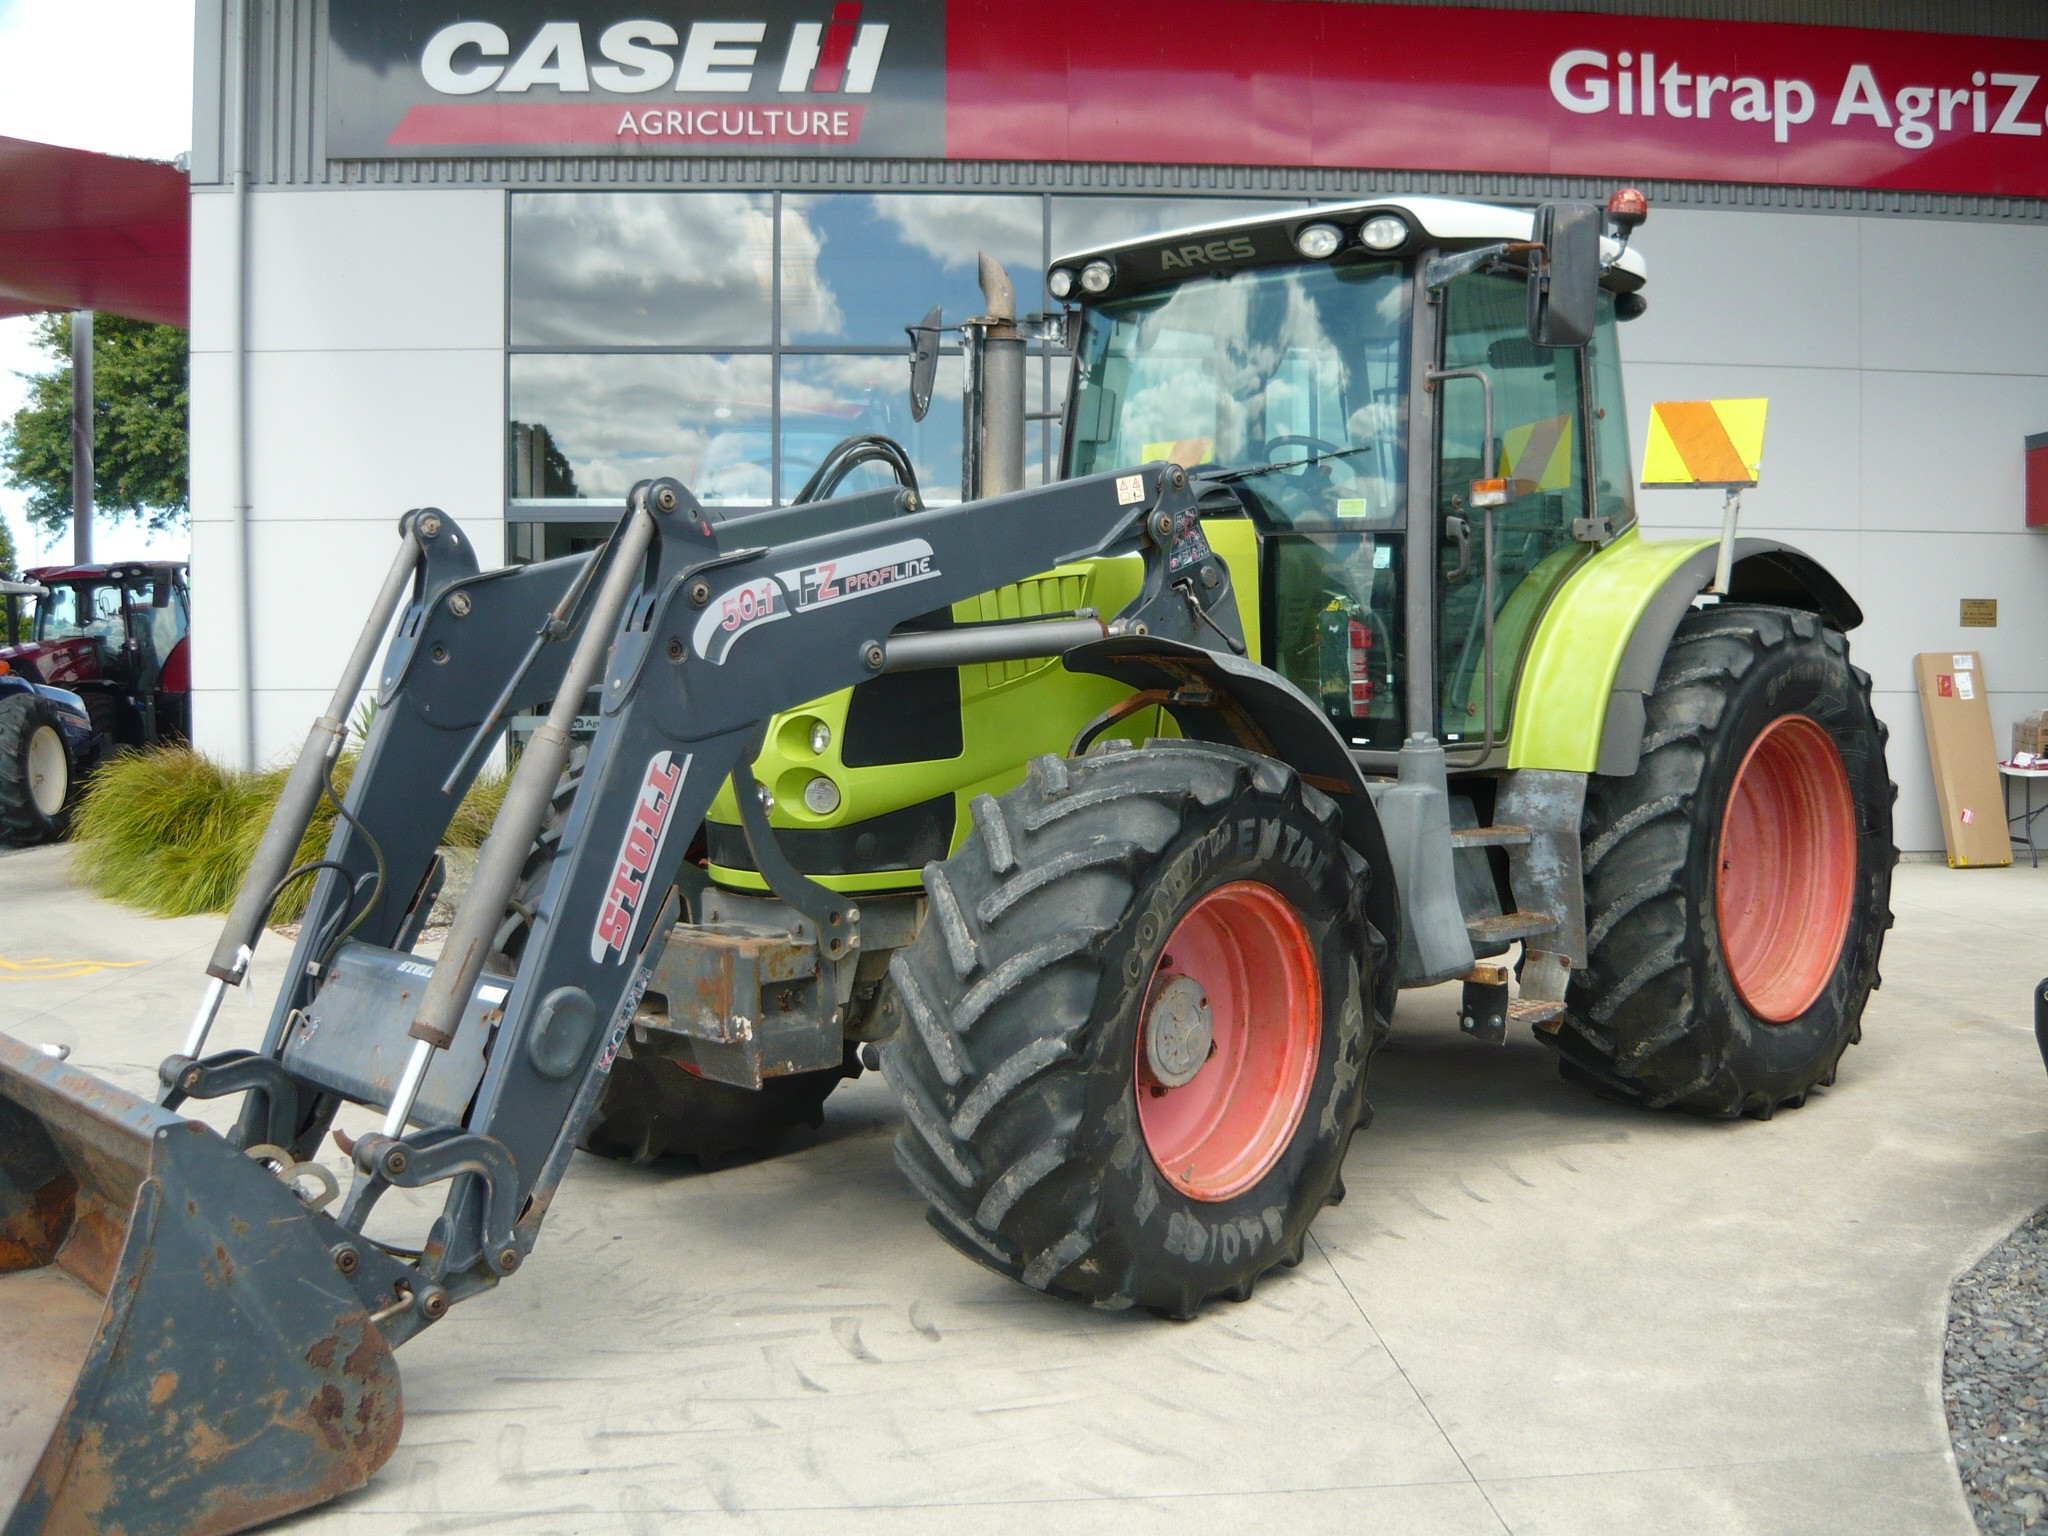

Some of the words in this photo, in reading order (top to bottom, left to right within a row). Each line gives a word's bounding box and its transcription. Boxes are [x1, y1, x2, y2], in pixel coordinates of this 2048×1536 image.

[420, 20, 767, 95] CASE
[616, 108, 849, 138] AGRICULTURE
[1549, 48, 1816, 144] Giltrap
[1830, 64, 2048, 150] AgriZ
[1161, 236, 1256, 271] ARES
[721, 582, 774, 632] 50.1
[798, 563, 840, 607] FZ
[845, 557, 931, 594] PROFILINE
[598, 762, 681, 951] STOLL
